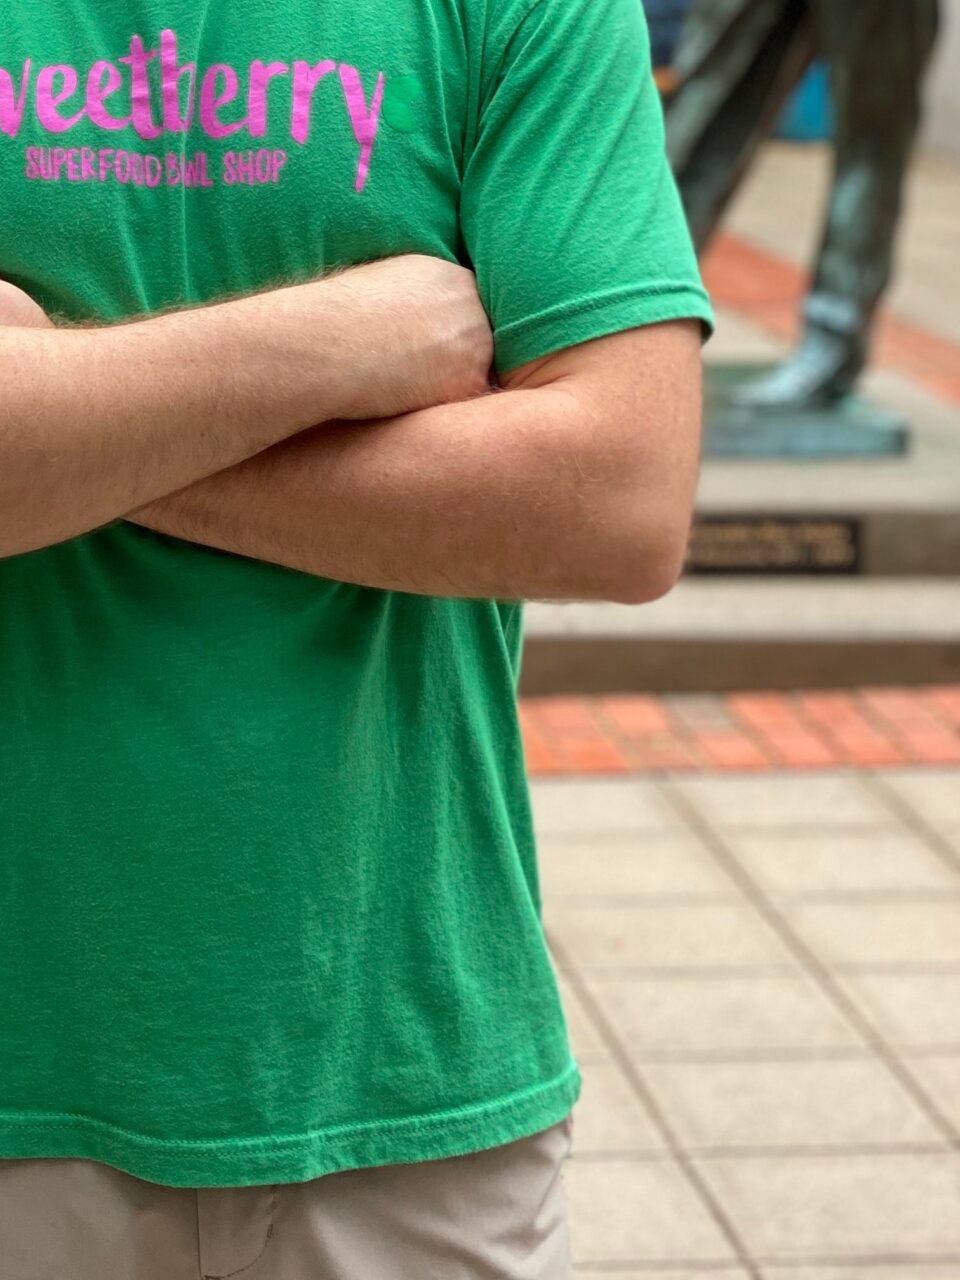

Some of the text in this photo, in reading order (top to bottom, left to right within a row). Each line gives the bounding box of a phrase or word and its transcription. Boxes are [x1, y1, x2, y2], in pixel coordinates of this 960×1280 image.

[24, 146, 288, 188] SUPERFOOD BWL SHOP
